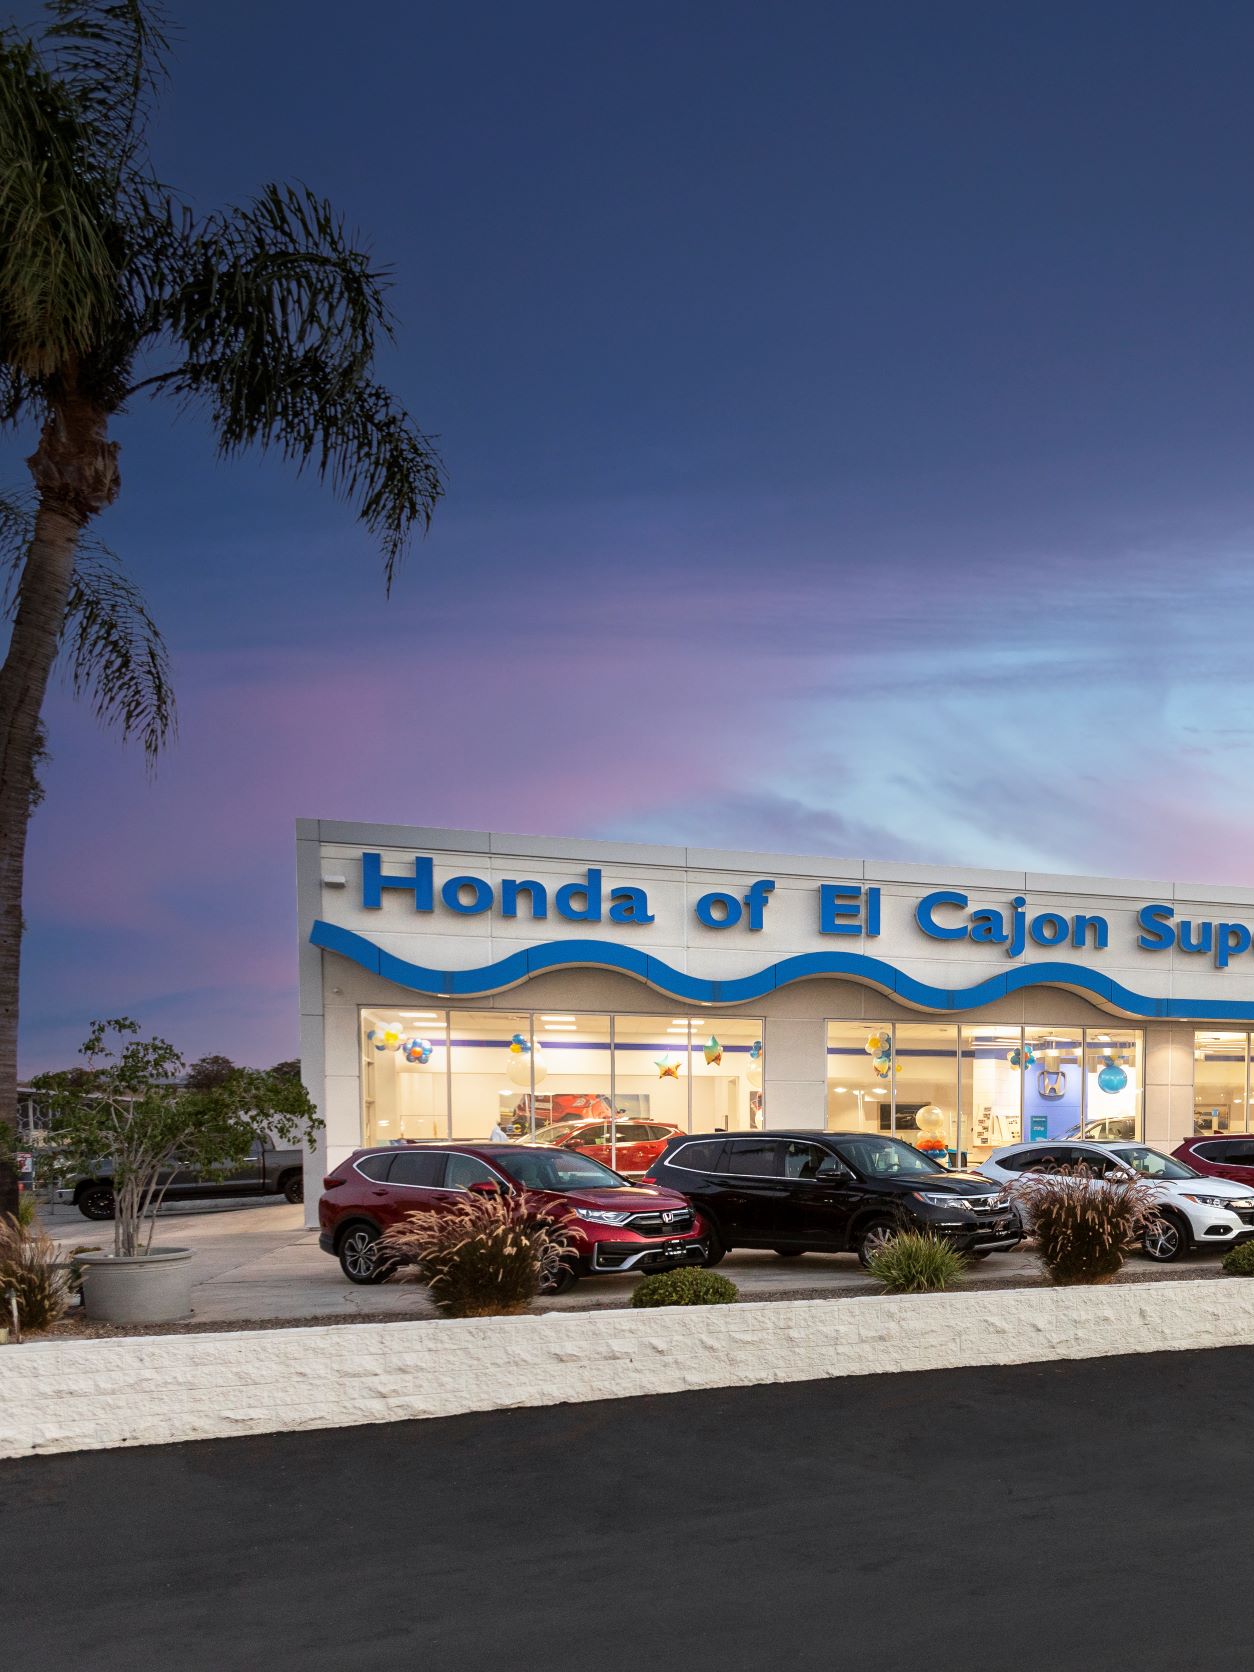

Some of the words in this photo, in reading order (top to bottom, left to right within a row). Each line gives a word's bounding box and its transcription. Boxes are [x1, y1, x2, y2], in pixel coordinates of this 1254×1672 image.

[361, 852, 656, 926] Honda
[696, 879, 776, 931] of
[819, 883, 882, 938] El
[915, 890, 1111, 959] Cajon
